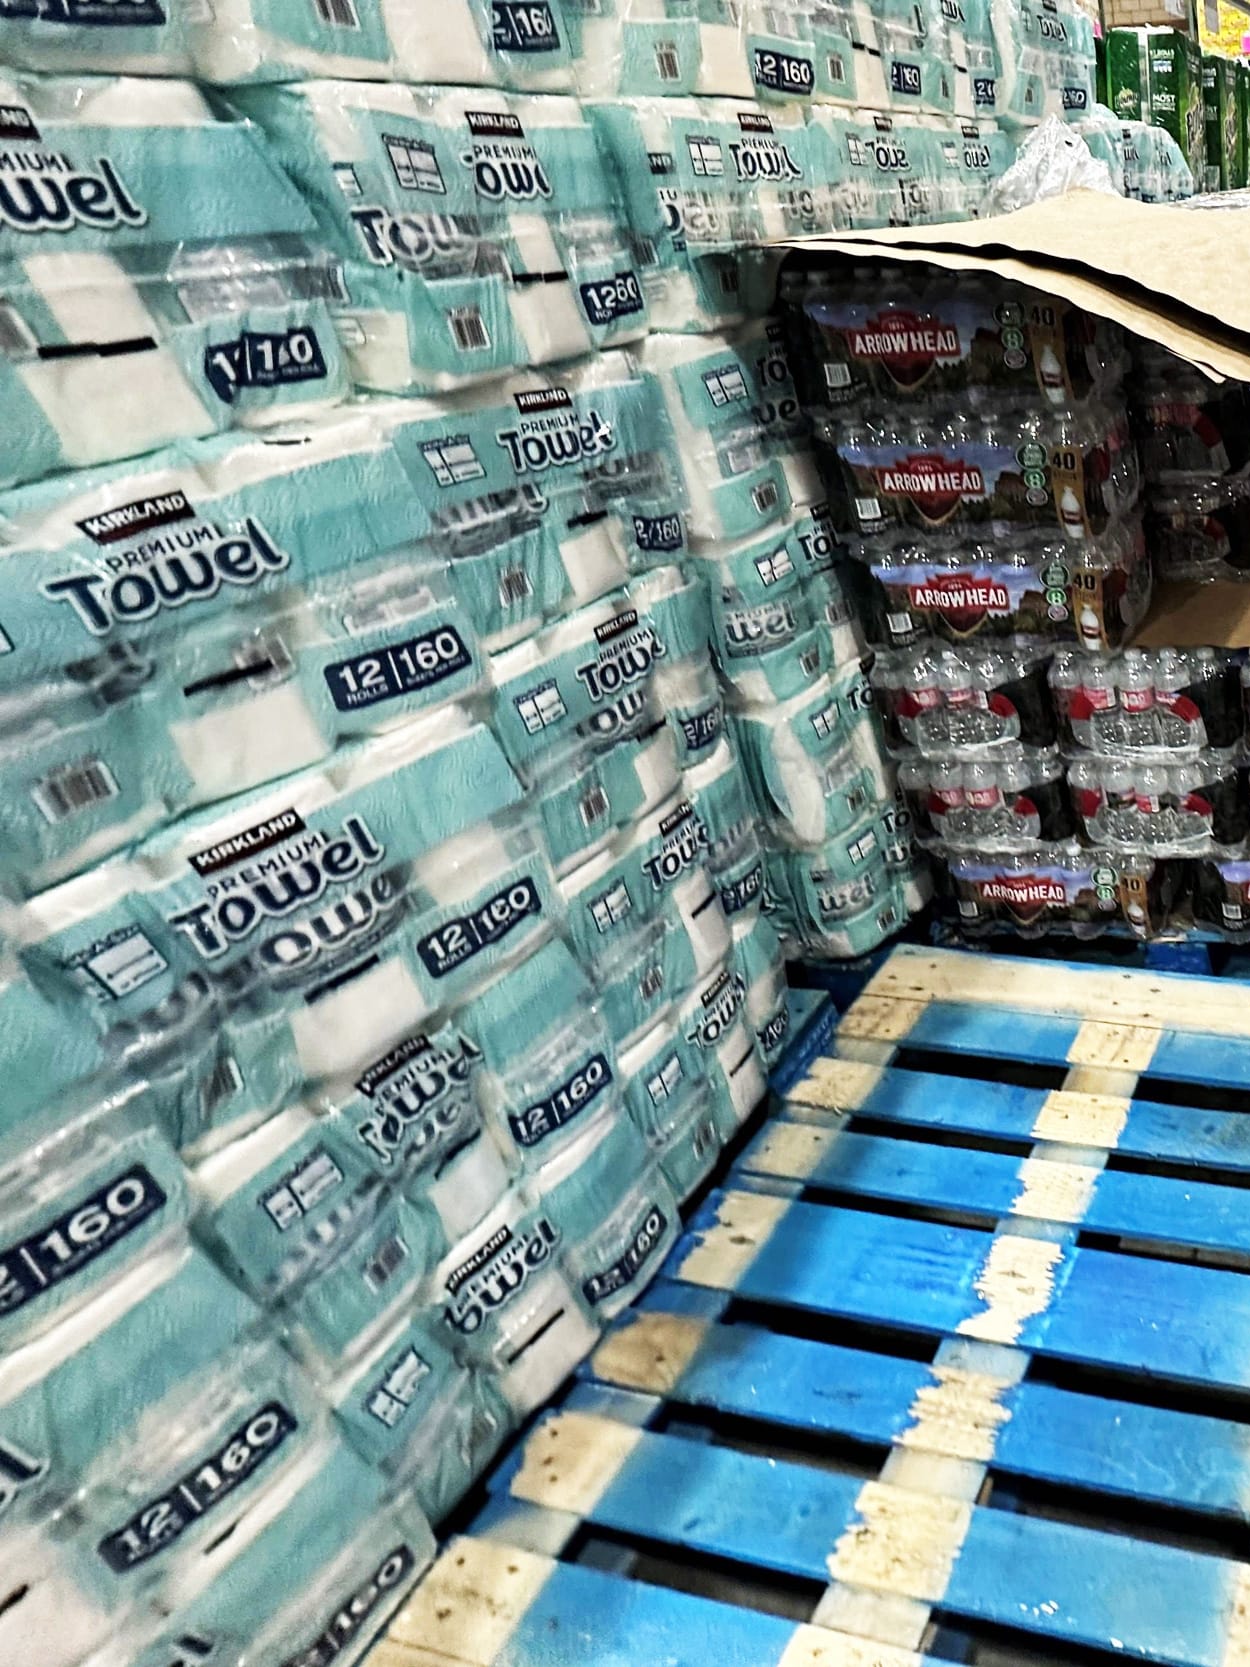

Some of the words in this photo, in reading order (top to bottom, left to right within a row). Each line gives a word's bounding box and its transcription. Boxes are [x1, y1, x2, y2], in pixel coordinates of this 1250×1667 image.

[782, 60, 810, 84] 160
[854, 330, 957, 355] ARROWHEAD
[883, 470, 981, 493] ARROWHEAD
[1052, 452, 1075, 470] 40
[83, 494, 187, 535] KIRKLAND
[46, 517, 284, 629] Towel
[1073, 572, 1096, 591] 40
[915, 587, 1007, 608] ARROWHEAD
[338, 659, 386, 693] 12
[399, 632, 460, 676] 160
[197, 812, 296, 866] KIRKLAND
[169, 817, 380, 952] Towel
[983, 883, 1064, 902] ARROWHEAD
[427, 924, 467, 960] 12
[481, 885, 531, 932] 160
[517, 1107, 546, 1137] 12
[558, 1060, 603, 1110] 160
[118, 1502, 175, 1552] 12
[199, 1411, 281, 1490] 160
